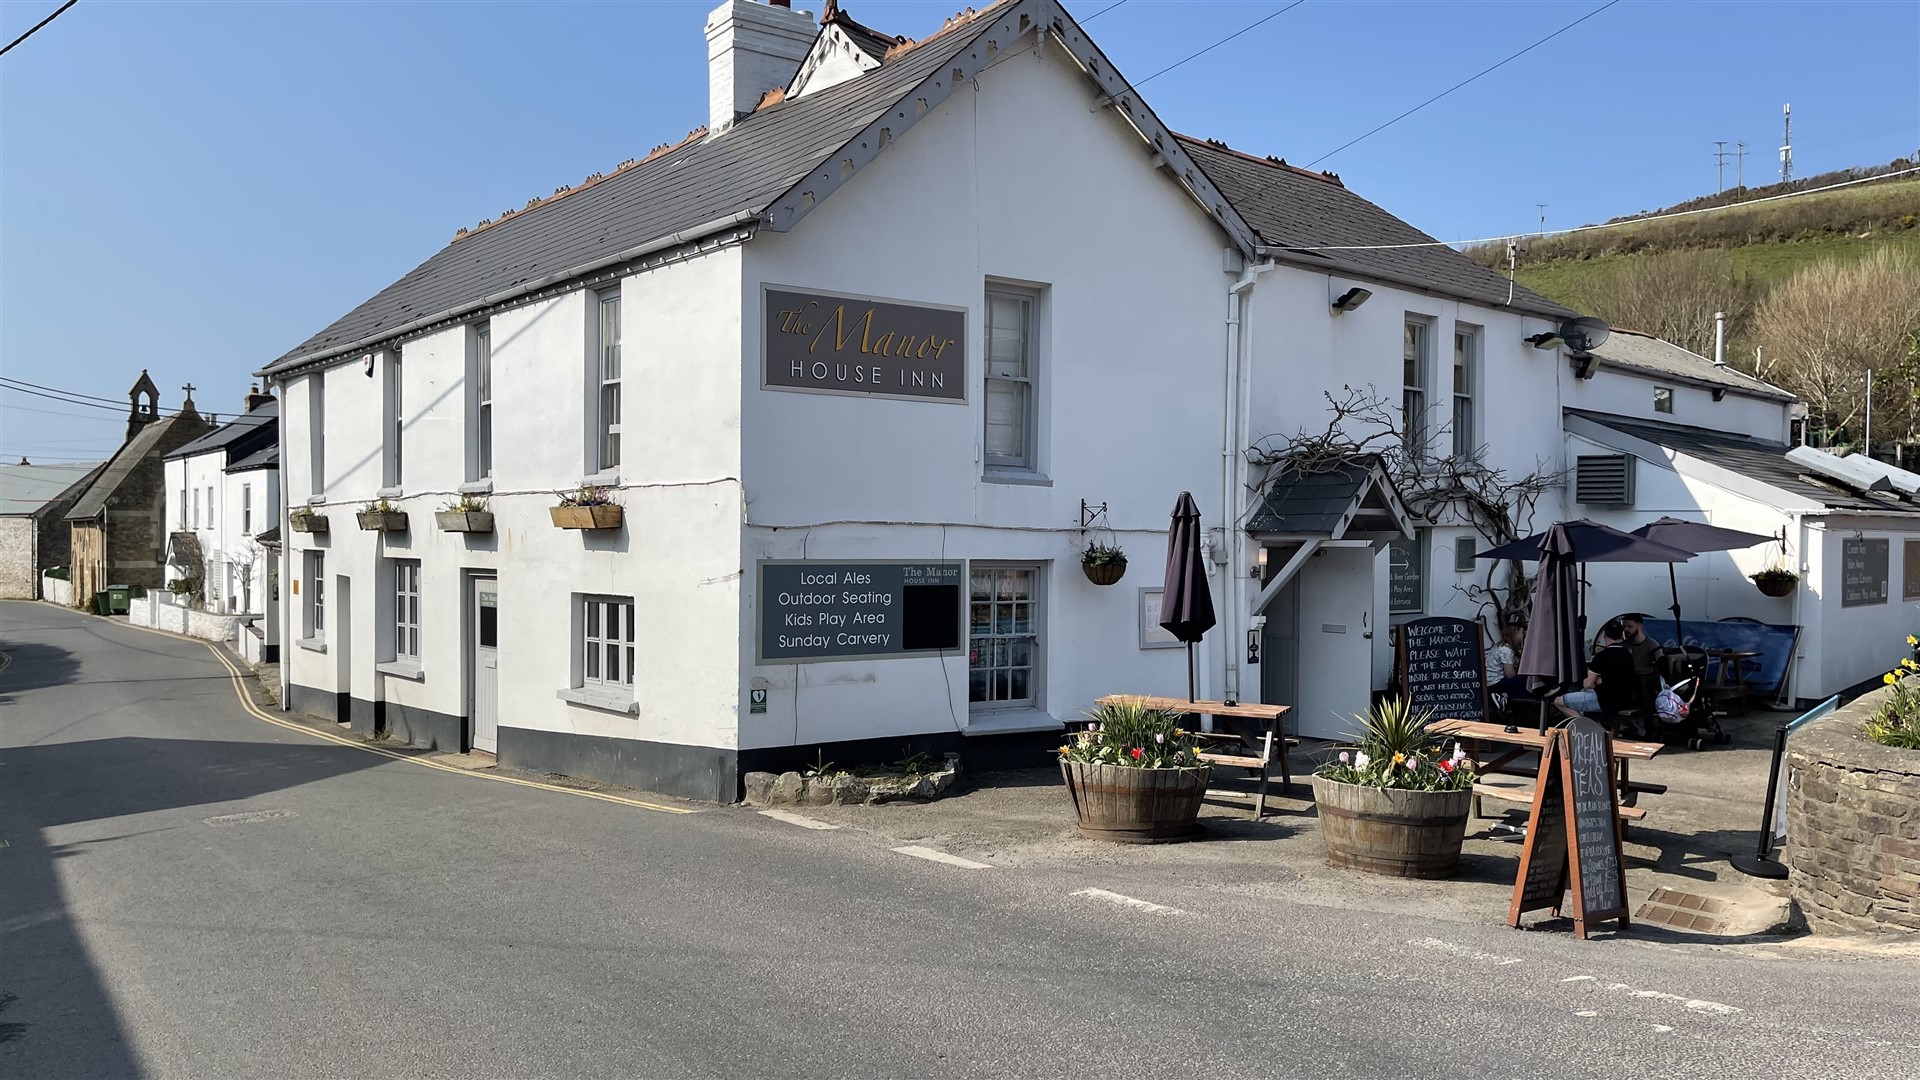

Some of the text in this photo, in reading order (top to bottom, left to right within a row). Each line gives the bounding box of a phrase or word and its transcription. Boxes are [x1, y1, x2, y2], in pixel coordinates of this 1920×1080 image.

[776, 301, 956, 361] The Manor
[790, 359, 944, 389] HOUSE INN
[800, 571, 872, 586] Local Ales
[902, 566, 958, 577] The Manor
[778, 591, 892, 606] Outdoor Seating
[785, 612, 885, 628] Kids Play Area
[1407, 624, 1464, 638] WELCOME TO
[778, 632, 891, 649] Sunday Carvery
[1407, 637, 1426, 648] THE
[1409, 647, 1471, 661] PLEASE WAIT
[1408, 659, 1462, 673] AT THE SIGN
[1408, 669, 1478, 683] INSIDE TO BE SEATED
[1420, 683, 1436, 692] JUST
[1438, 682, 1460, 691] HELPS
[1461, 681, 1471, 689] US
[1471, 681, 1481, 689] TO
[1414, 693, 1435, 702] SERVE
[1436, 693, 1449, 701] YOU
[1568, 722, 1608, 767] CREAM
[1573, 765, 1604, 797] TEAS
